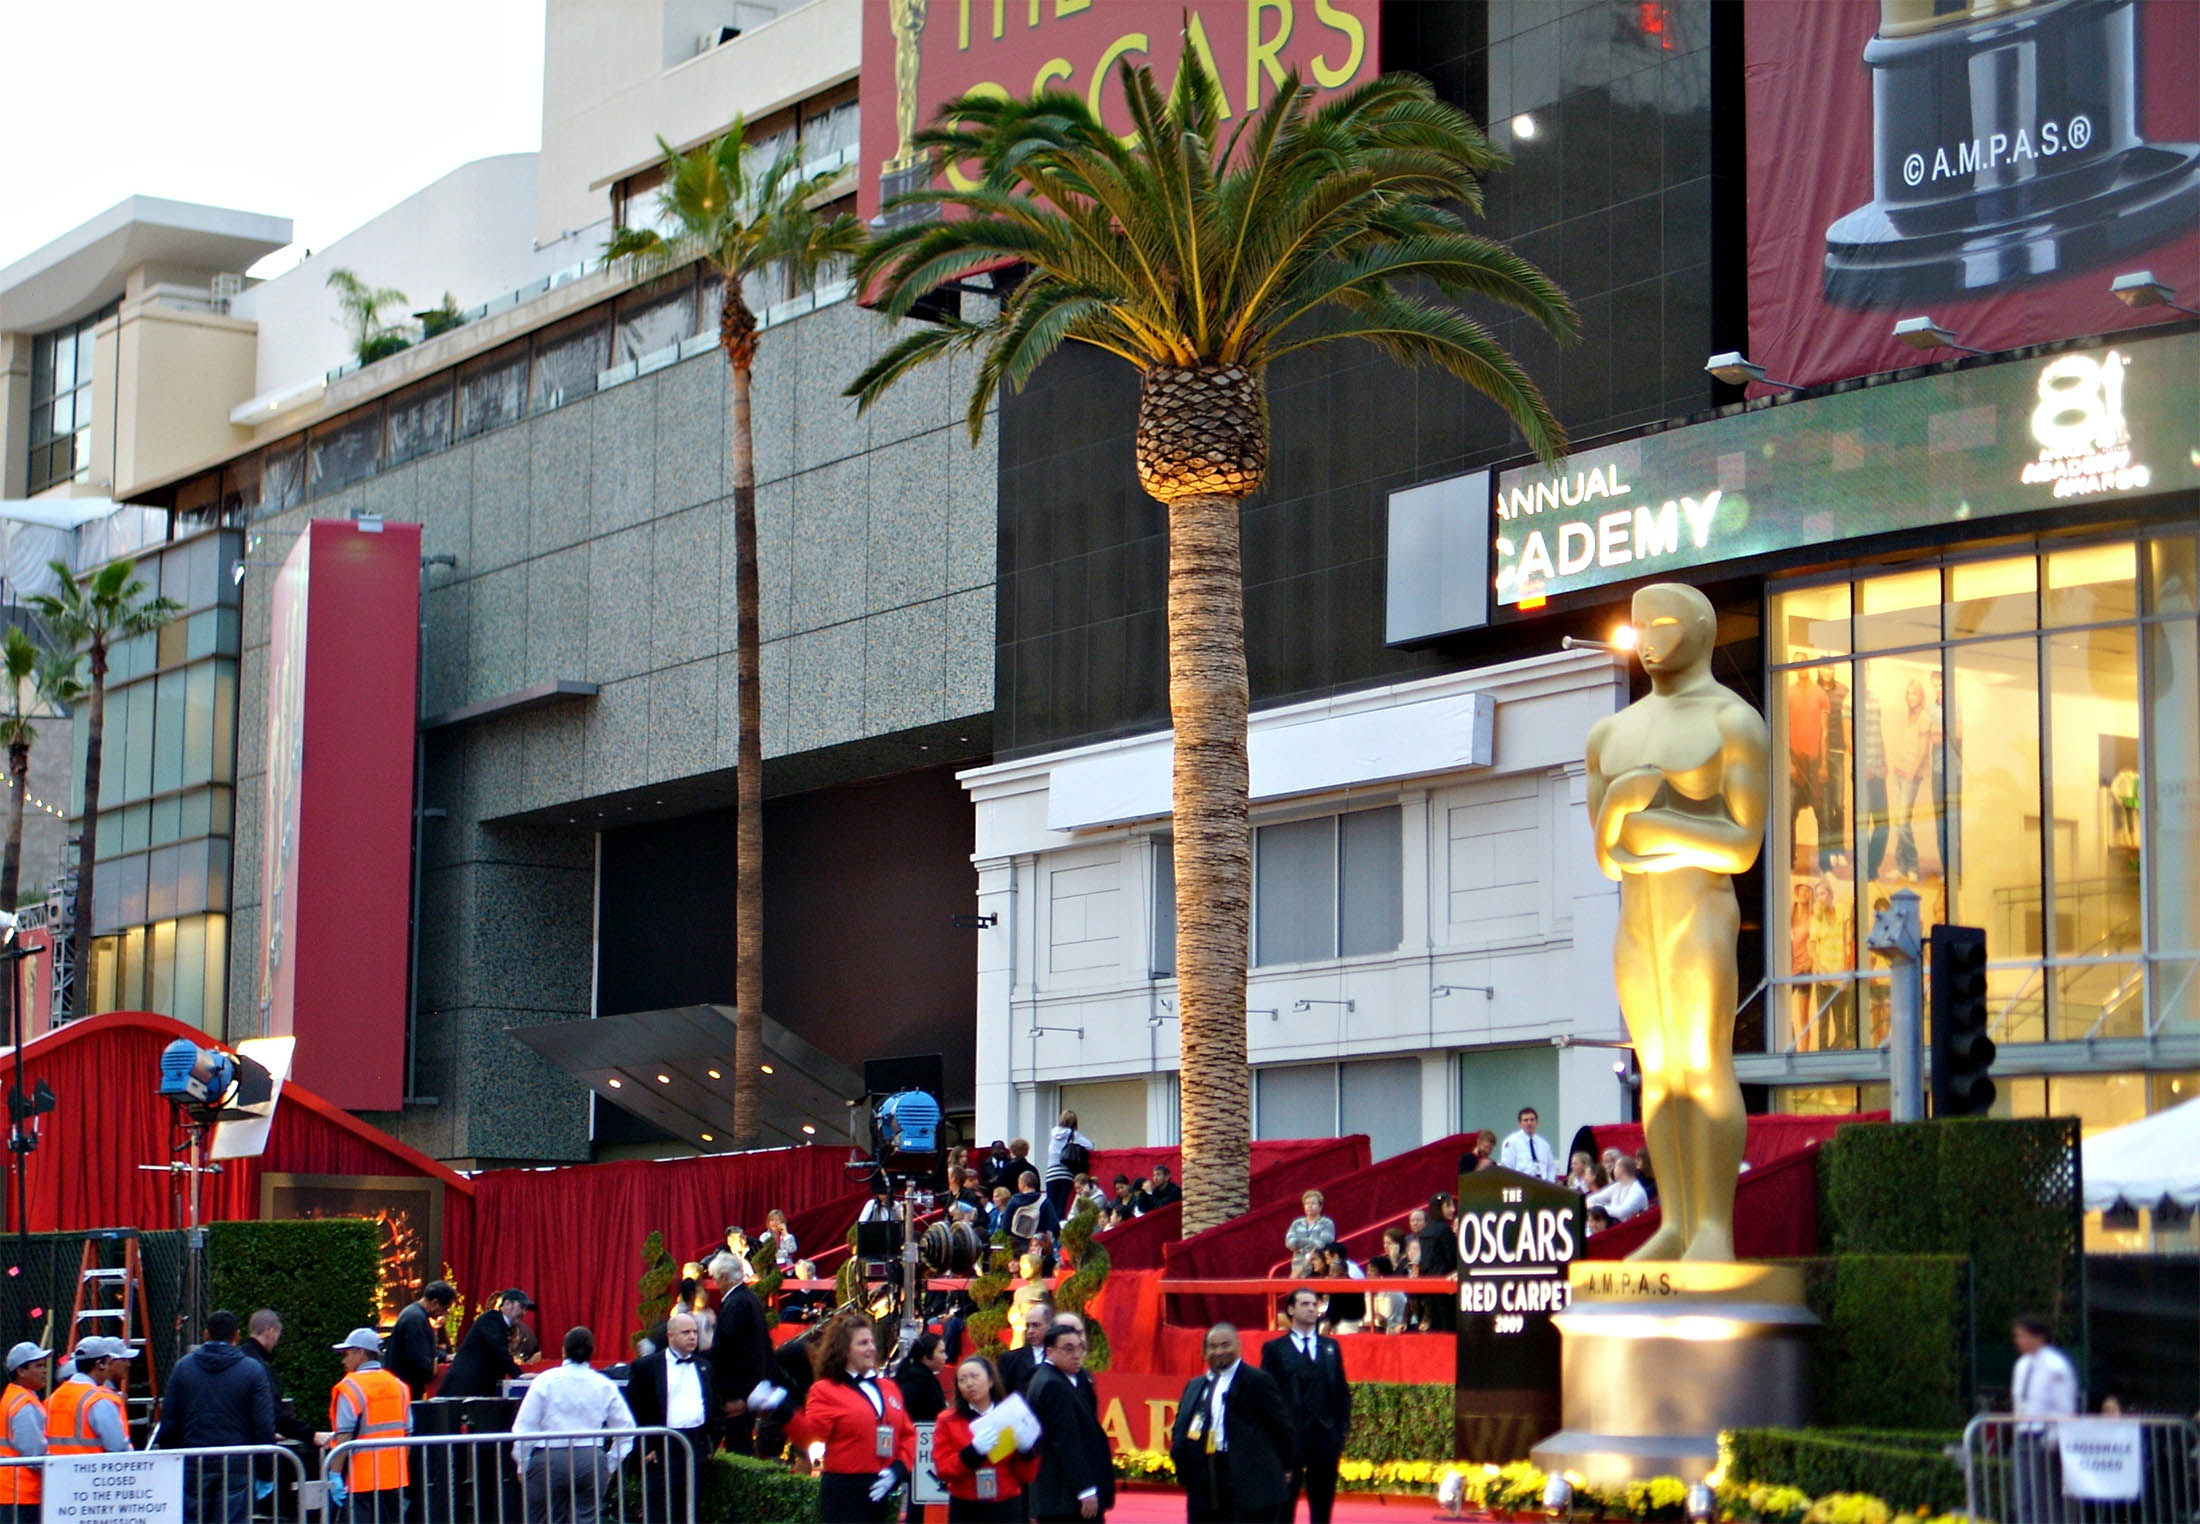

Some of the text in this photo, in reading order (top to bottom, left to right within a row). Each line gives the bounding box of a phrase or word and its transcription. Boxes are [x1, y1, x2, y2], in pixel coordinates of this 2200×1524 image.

[1502, 1188, 1522, 1203] THE
[1458, 1208, 1574, 1264] OSCARS
[1461, 1279, 1572, 1312] RED CARPET
[73, 1461, 154, 1473] THIS PROPERTY
[92, 1476, 136, 1486] CLOSED
[73, 1489, 153, 1501] TO THE PUBLIC
[58, 1502, 167, 1516] NO ENTRY WITHOUT
